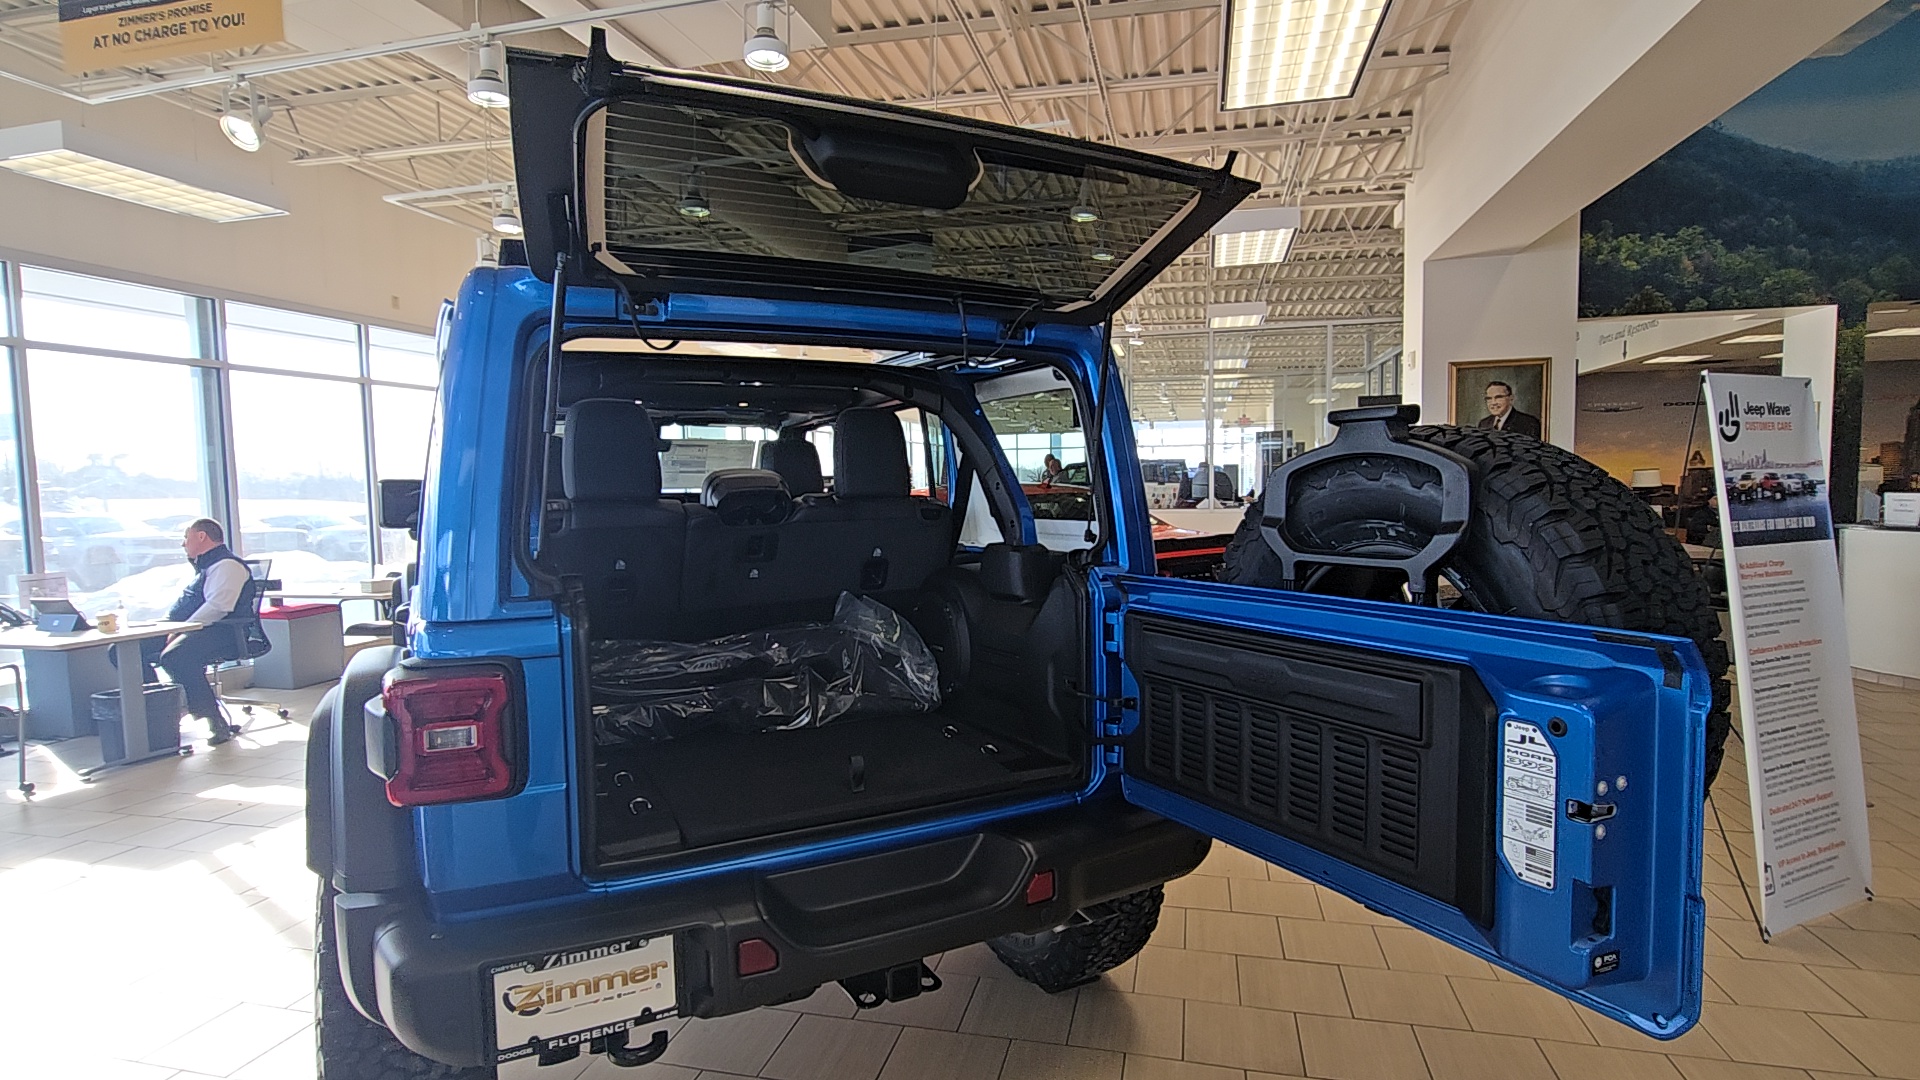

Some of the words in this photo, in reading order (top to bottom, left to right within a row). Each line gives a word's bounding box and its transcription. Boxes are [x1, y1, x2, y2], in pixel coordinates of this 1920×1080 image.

[118, 11, 164, 28] ZIMMER'S
[167, 2, 213, 21] PROMISE
[93, 34, 109, 49] AT
[112, 32, 131, 46] NO
[134, 22, 187, 43] CHARGE
[192, 18, 209, 33] TO
[212, 12, 246, 30] YOU!
[1743, 401, 1766, 418] Jeep
[1766, 401, 1791, 416] Wave
[1745, 421, 1775, 431] CUSTOMER
[1776, 421, 1793, 431] CARE
[1513, 724, 1530, 732] Jeep
[1507, 734, 1547, 747] JL
[1507, 748, 1553, 763] MOAB
[1507, 755, 1553, 774] 392
[543, 940, 631, 970] Zimmer
[490, 961, 528, 974] CHRYSLER
[514, 960, 668, 1011] Zimmer
[656, 1009, 679, 1020] RAM
[548, 1020, 635, 1050] FLORENCE
[497, 1047, 534, 1062] DODGE
